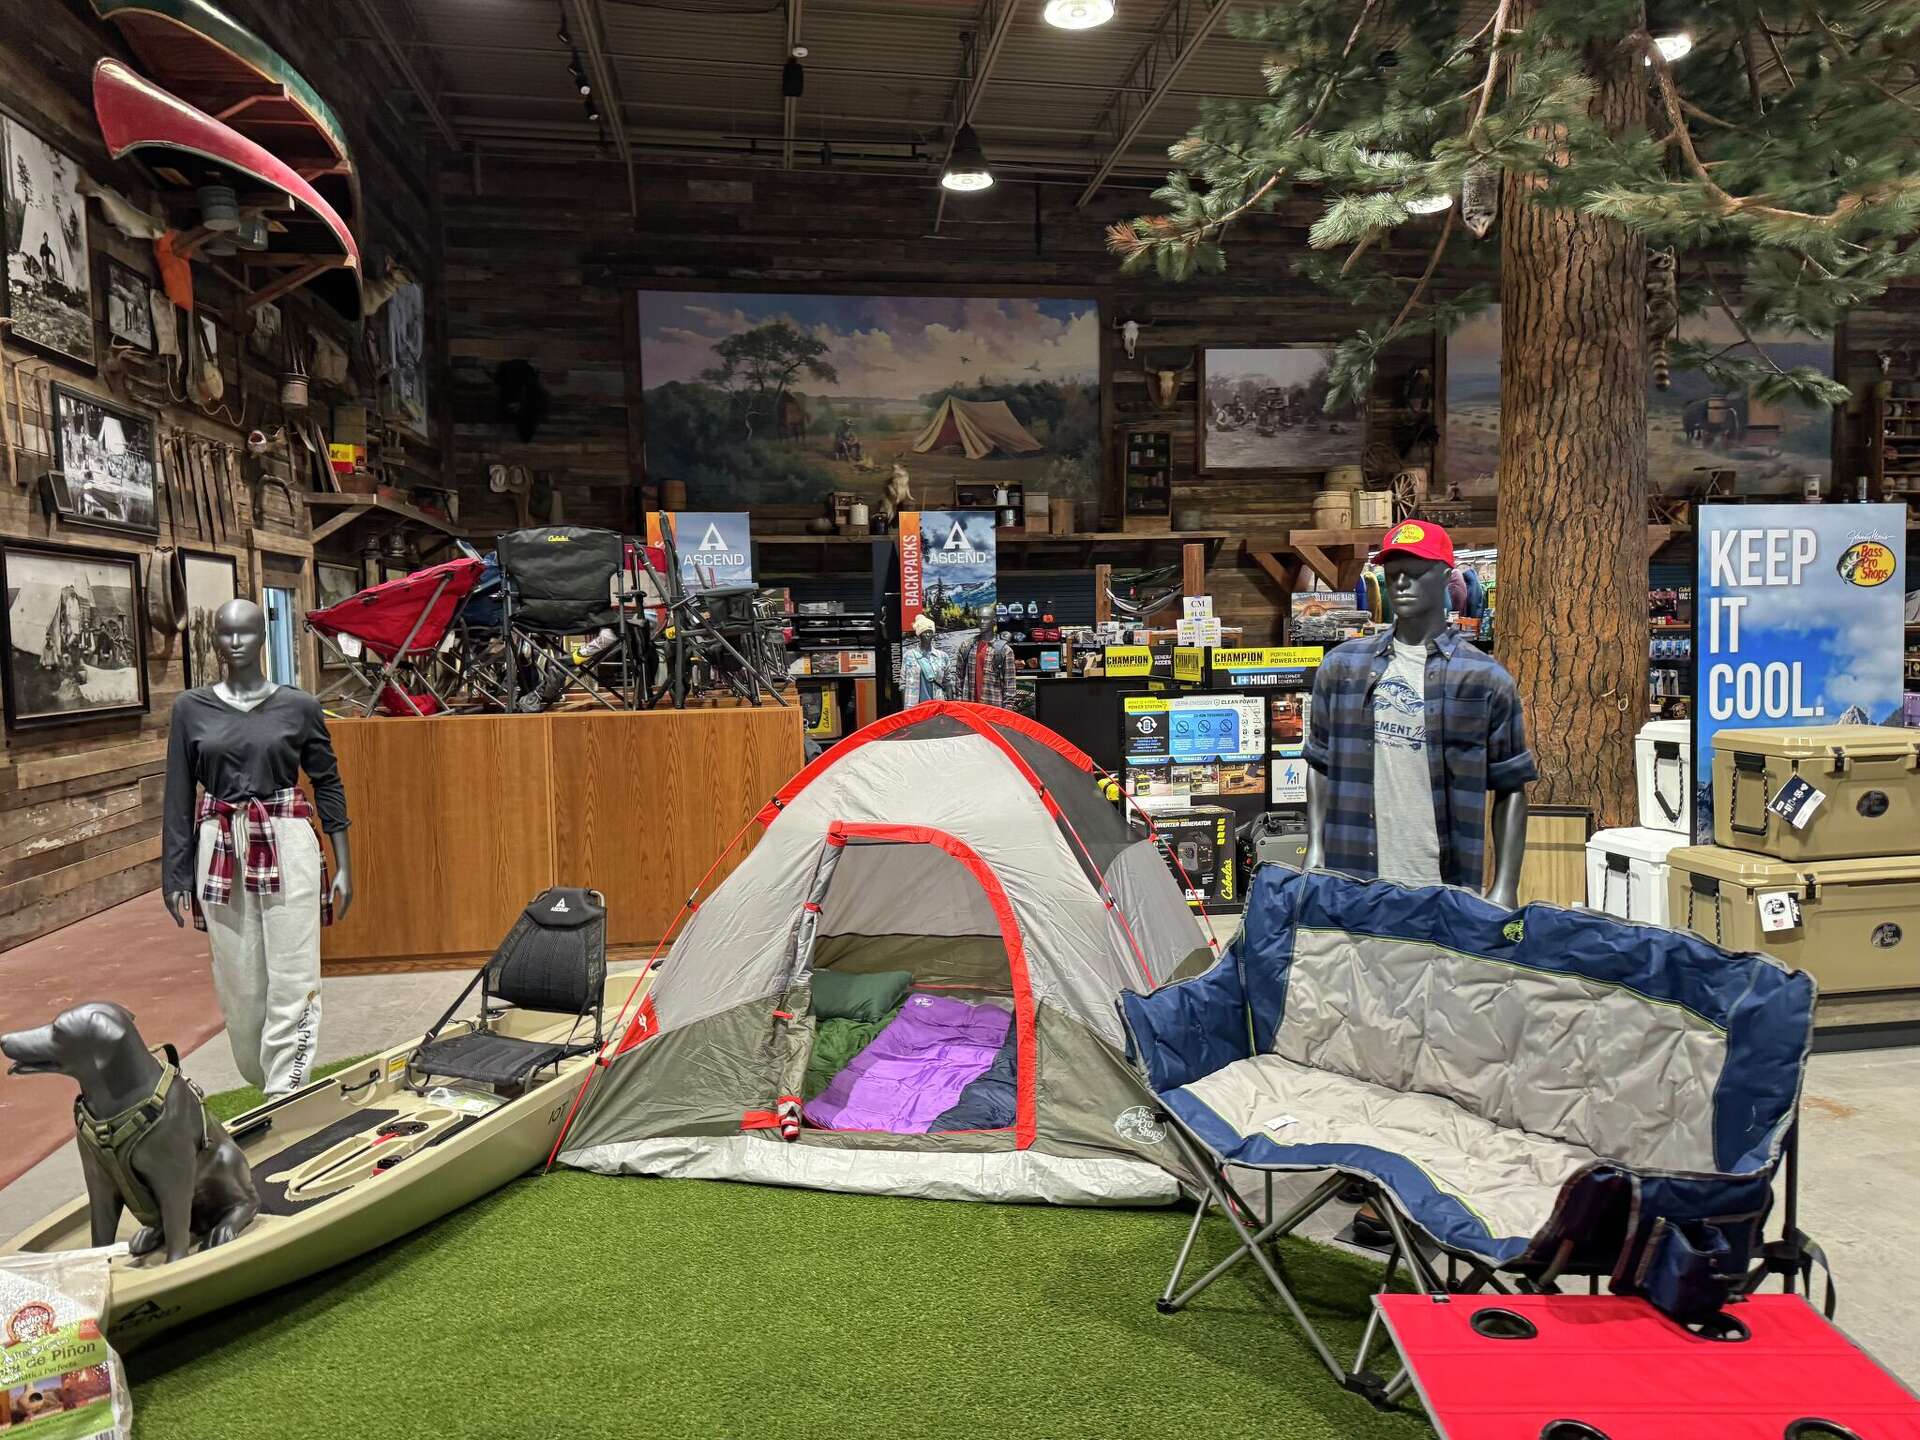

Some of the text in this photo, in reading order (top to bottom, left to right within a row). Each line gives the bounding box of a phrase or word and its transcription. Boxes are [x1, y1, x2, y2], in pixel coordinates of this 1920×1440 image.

[1861, 544, 1883, 557] Bass
[684, 553, 745, 566] ASCEND
[929, 551, 986, 564] ASCEND
[1710, 528, 1817, 587] KEEP
[1861, 557, 1878, 568] Pro
[903, 534, 919, 606] BACKPACKS
[1861, 568, 1889, 581] Shops
[1191, 600, 1205, 608] CM
[1709, 596, 1748, 654] IT
[891, 642, 900, 684] HYDRATION
[1107, 655, 1149, 665] CHAMPION
[1214, 651, 1263, 663] CHAMPION
[1709, 661, 1824, 721] COOL.
[1220, 857, 1233, 900] Cabela's
[1138, 1118, 1154, 1129] Pro
[1136, 1127, 1163, 1141] Shops
[51, 1341, 97, 1362] Piñon
